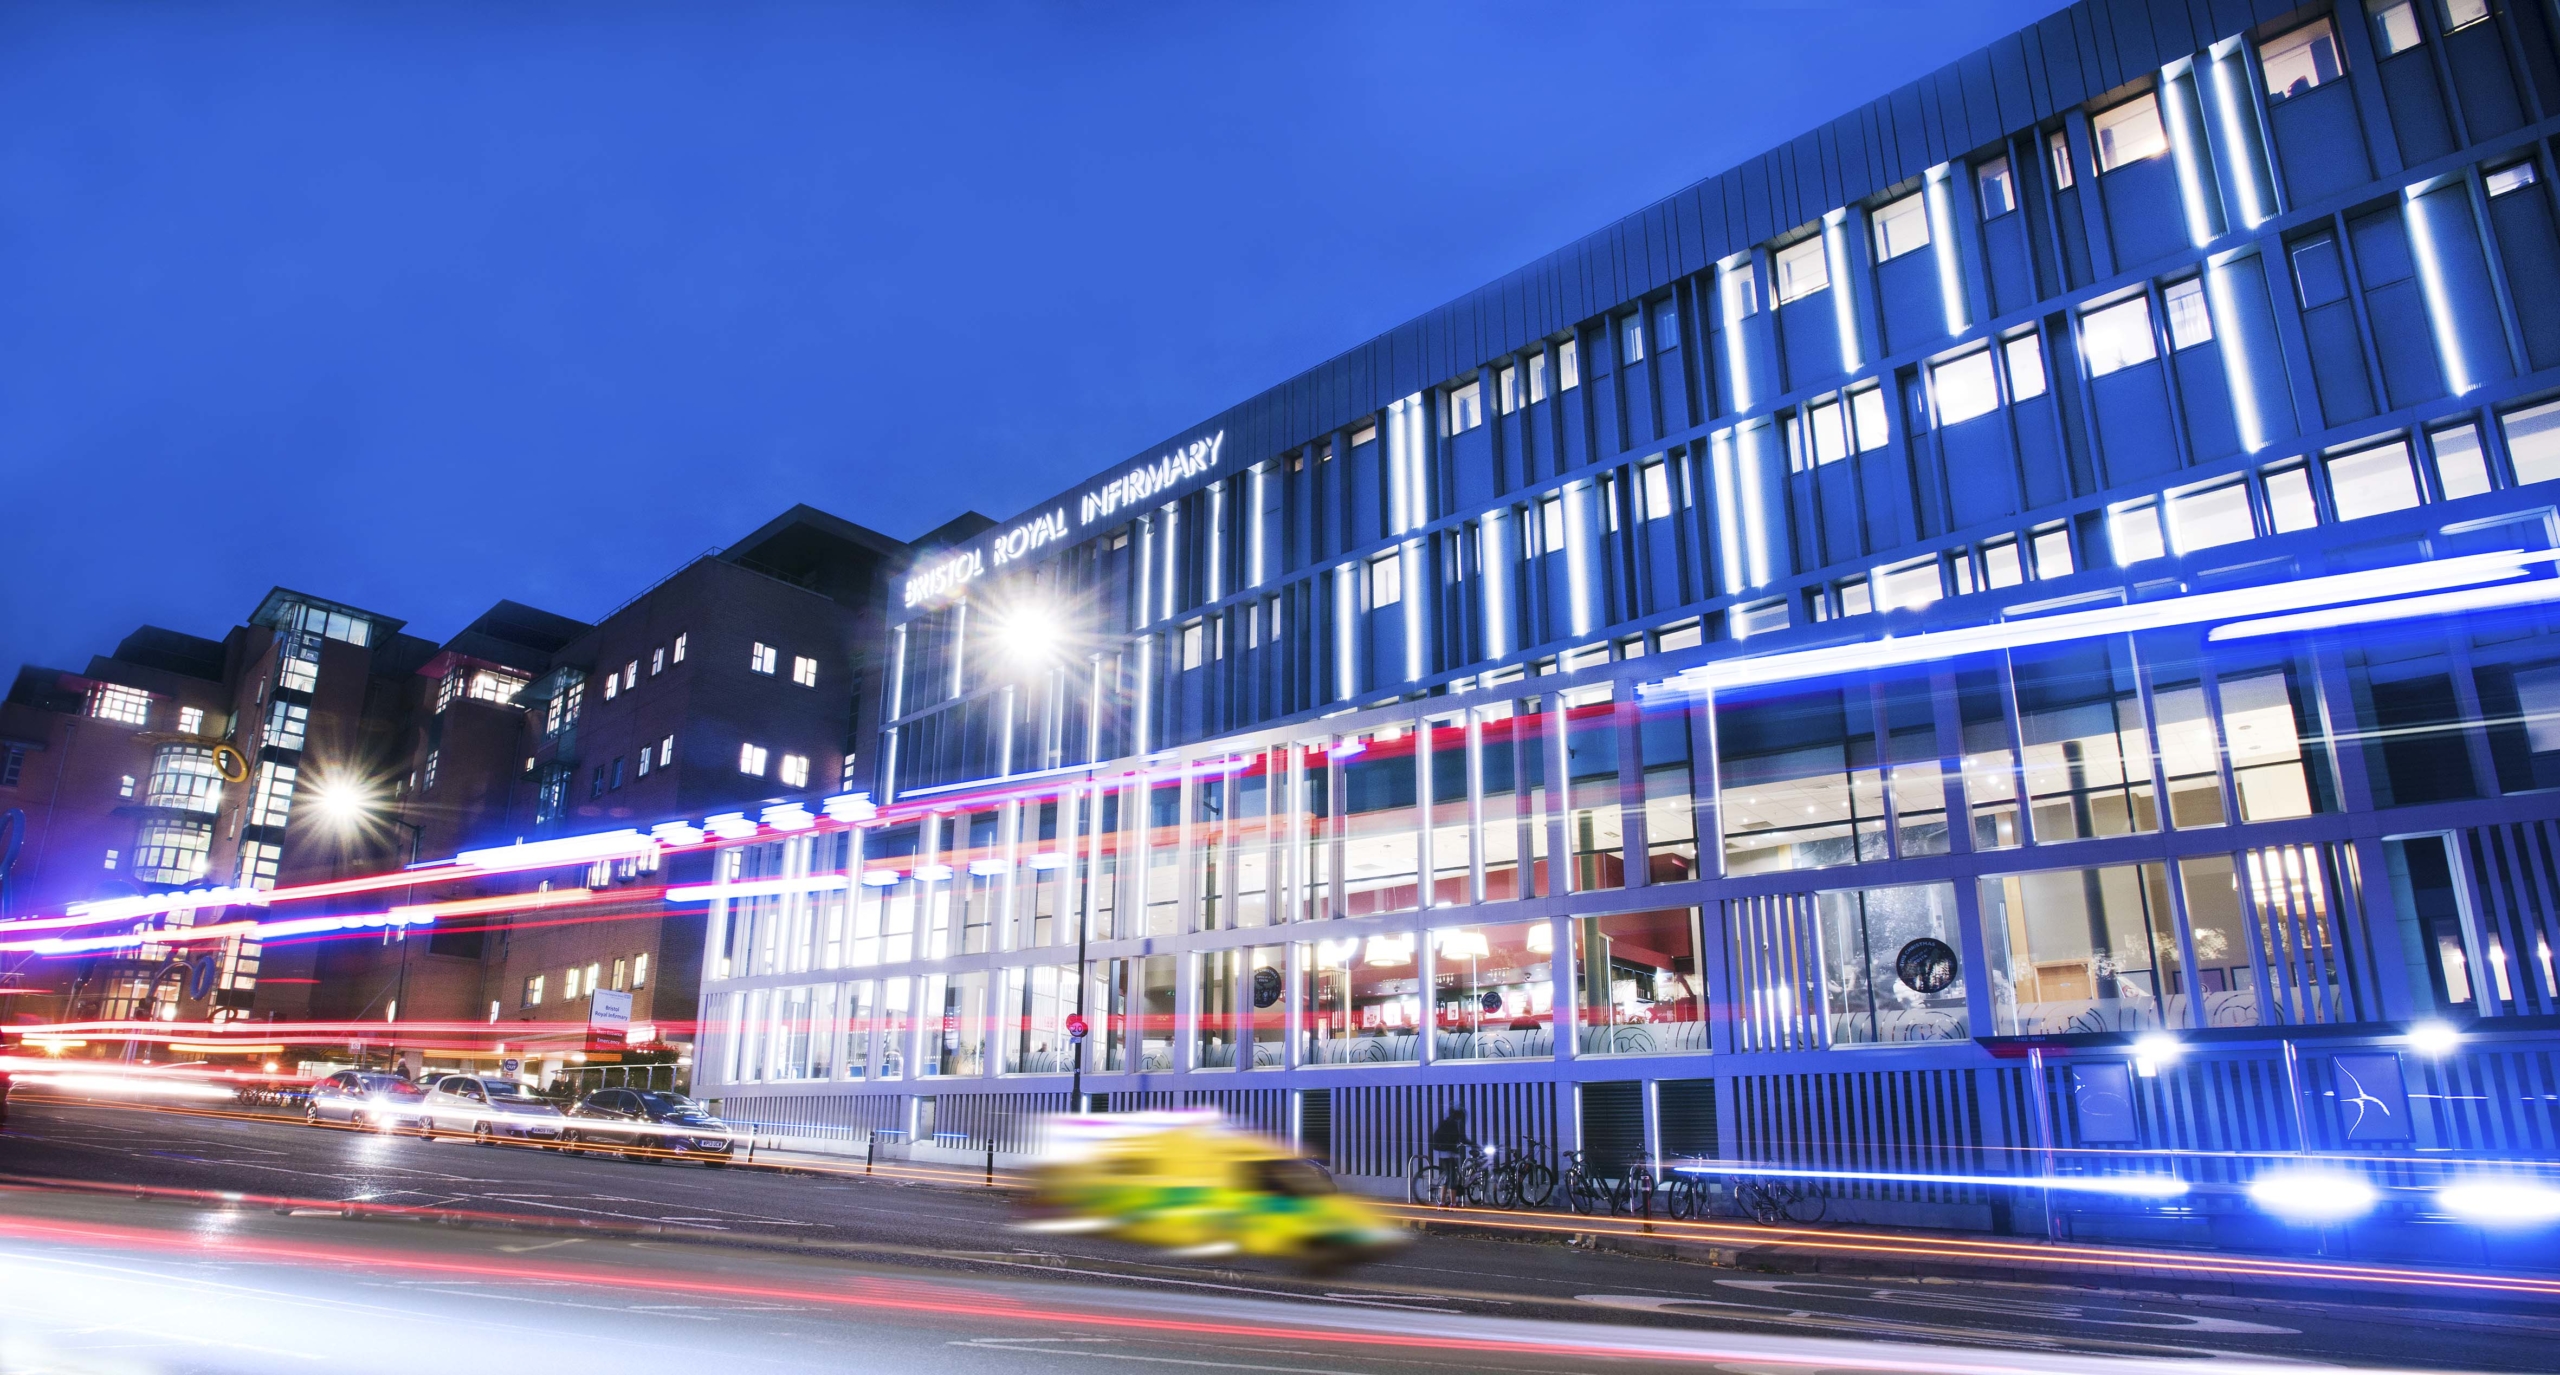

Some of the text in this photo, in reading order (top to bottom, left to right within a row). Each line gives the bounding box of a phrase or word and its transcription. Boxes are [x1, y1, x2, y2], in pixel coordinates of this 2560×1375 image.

[905, 430, 1225, 609] BRISTOL ROYAL INFIRMARY
[1904, 941, 1936, 955] CHRISTMAS
[595, 1010, 628, 1021] Royal Infirmary
[1070, 1025, 1082, 1033] 20
